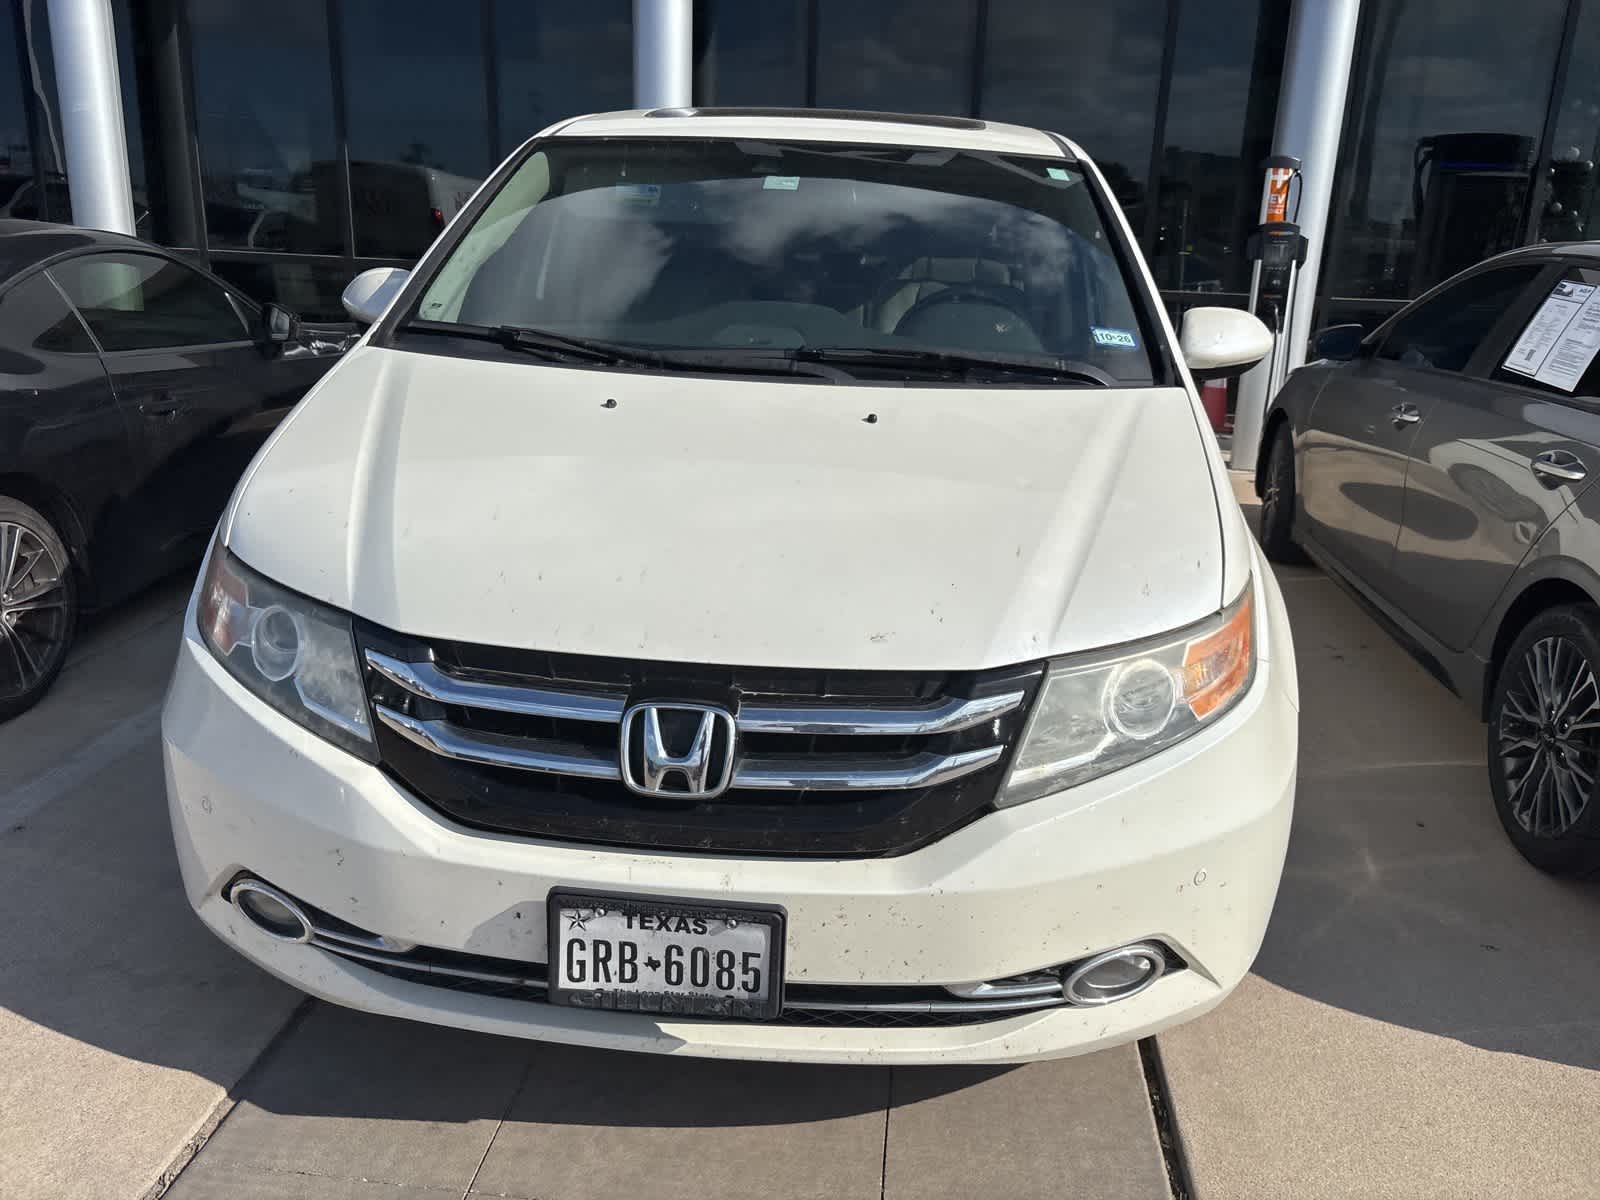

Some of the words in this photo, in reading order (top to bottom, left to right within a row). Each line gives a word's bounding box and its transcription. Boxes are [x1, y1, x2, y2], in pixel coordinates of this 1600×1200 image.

[622, 911, 708, 935] TEXAS
[566, 938, 639, 984] GRB
[664, 943, 762, 994] 6085
